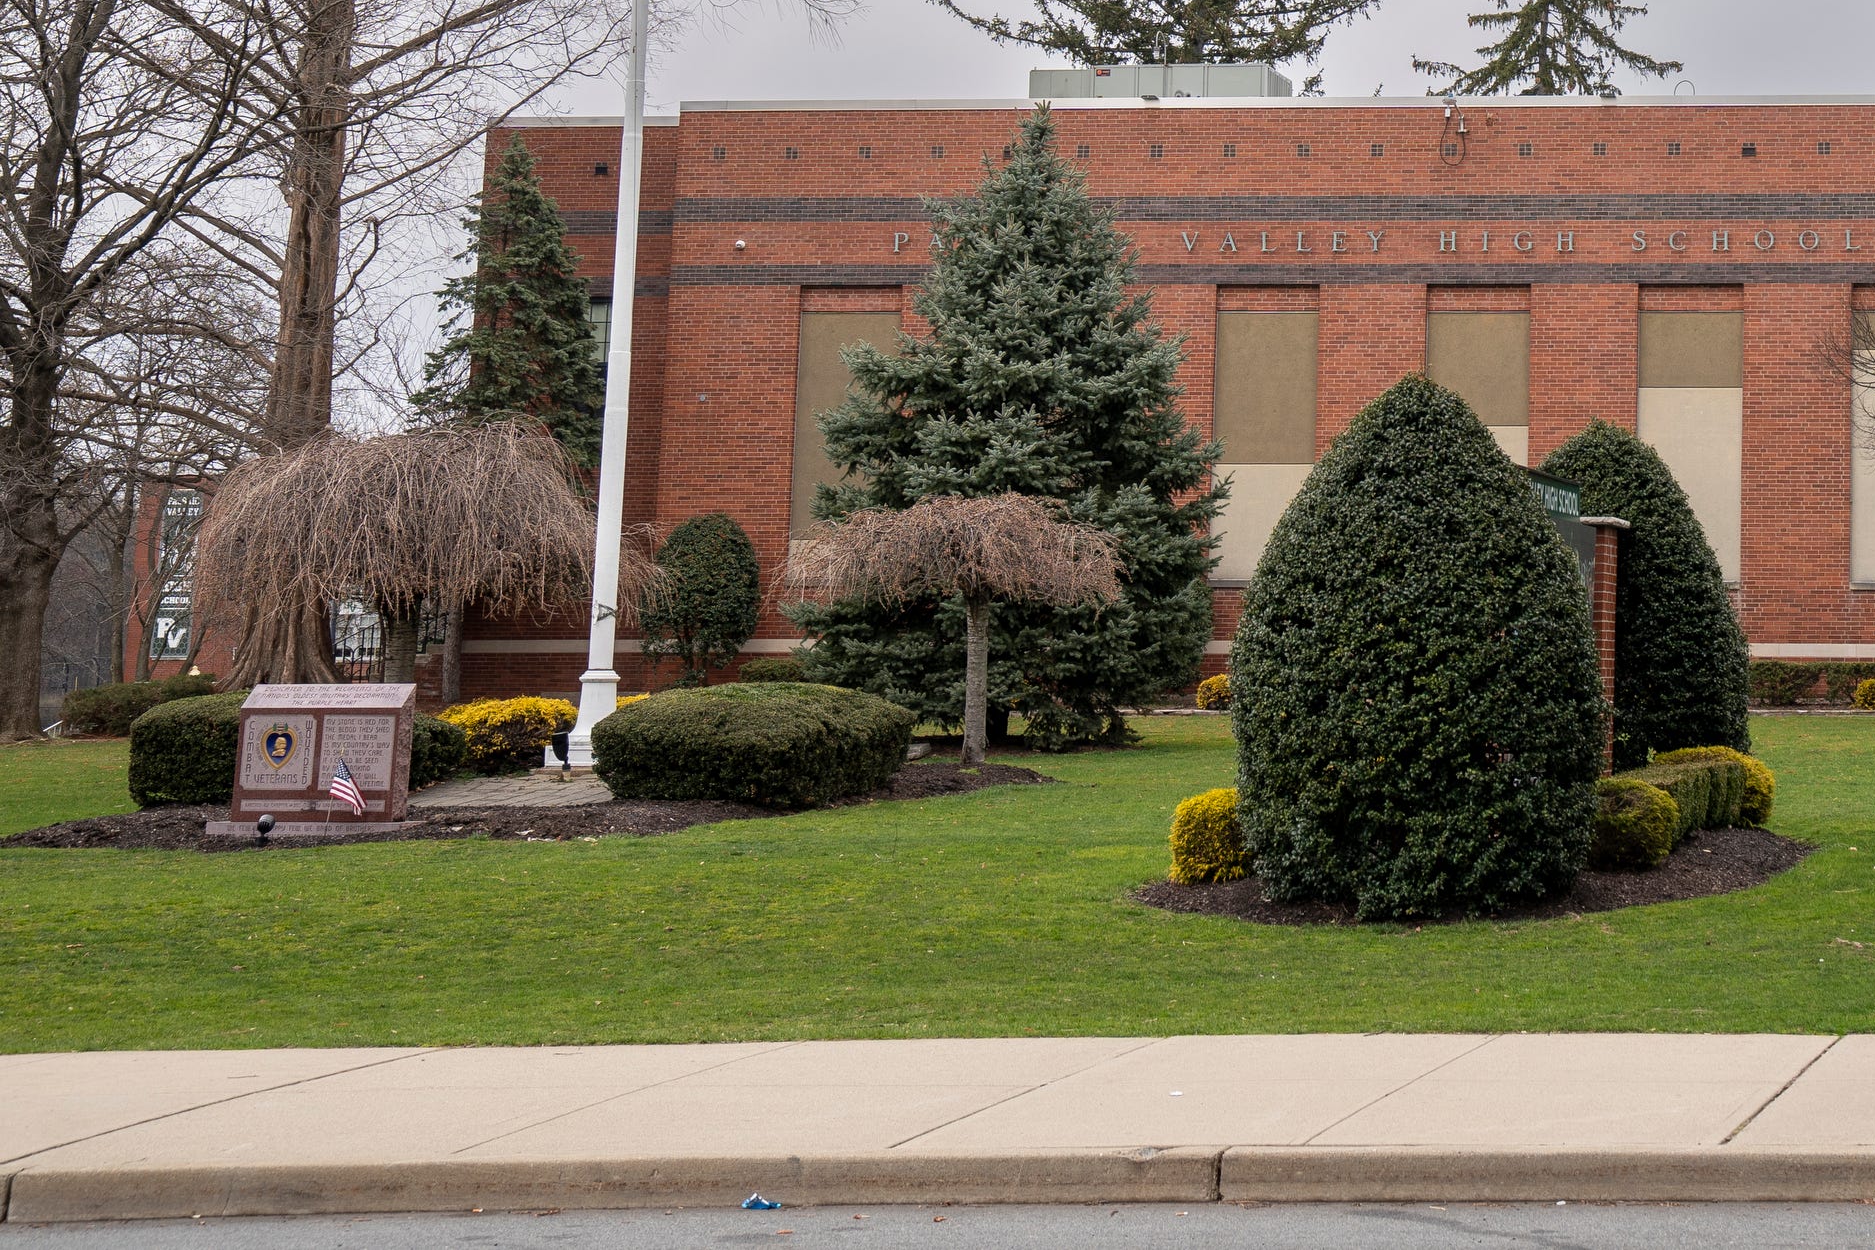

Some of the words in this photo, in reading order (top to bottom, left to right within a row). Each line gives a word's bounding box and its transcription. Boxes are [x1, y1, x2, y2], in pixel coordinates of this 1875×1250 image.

[1181, 230, 1385, 252] VALLEY
[1438, 230, 1576, 252] HIGH
[1631, 229, 1863, 252] SCHOOL
[1544, 485, 1559, 512] HIGH
[1559, 488, 1579, 517] SCHOOL
[254, 773, 298, 784] VETERANS
